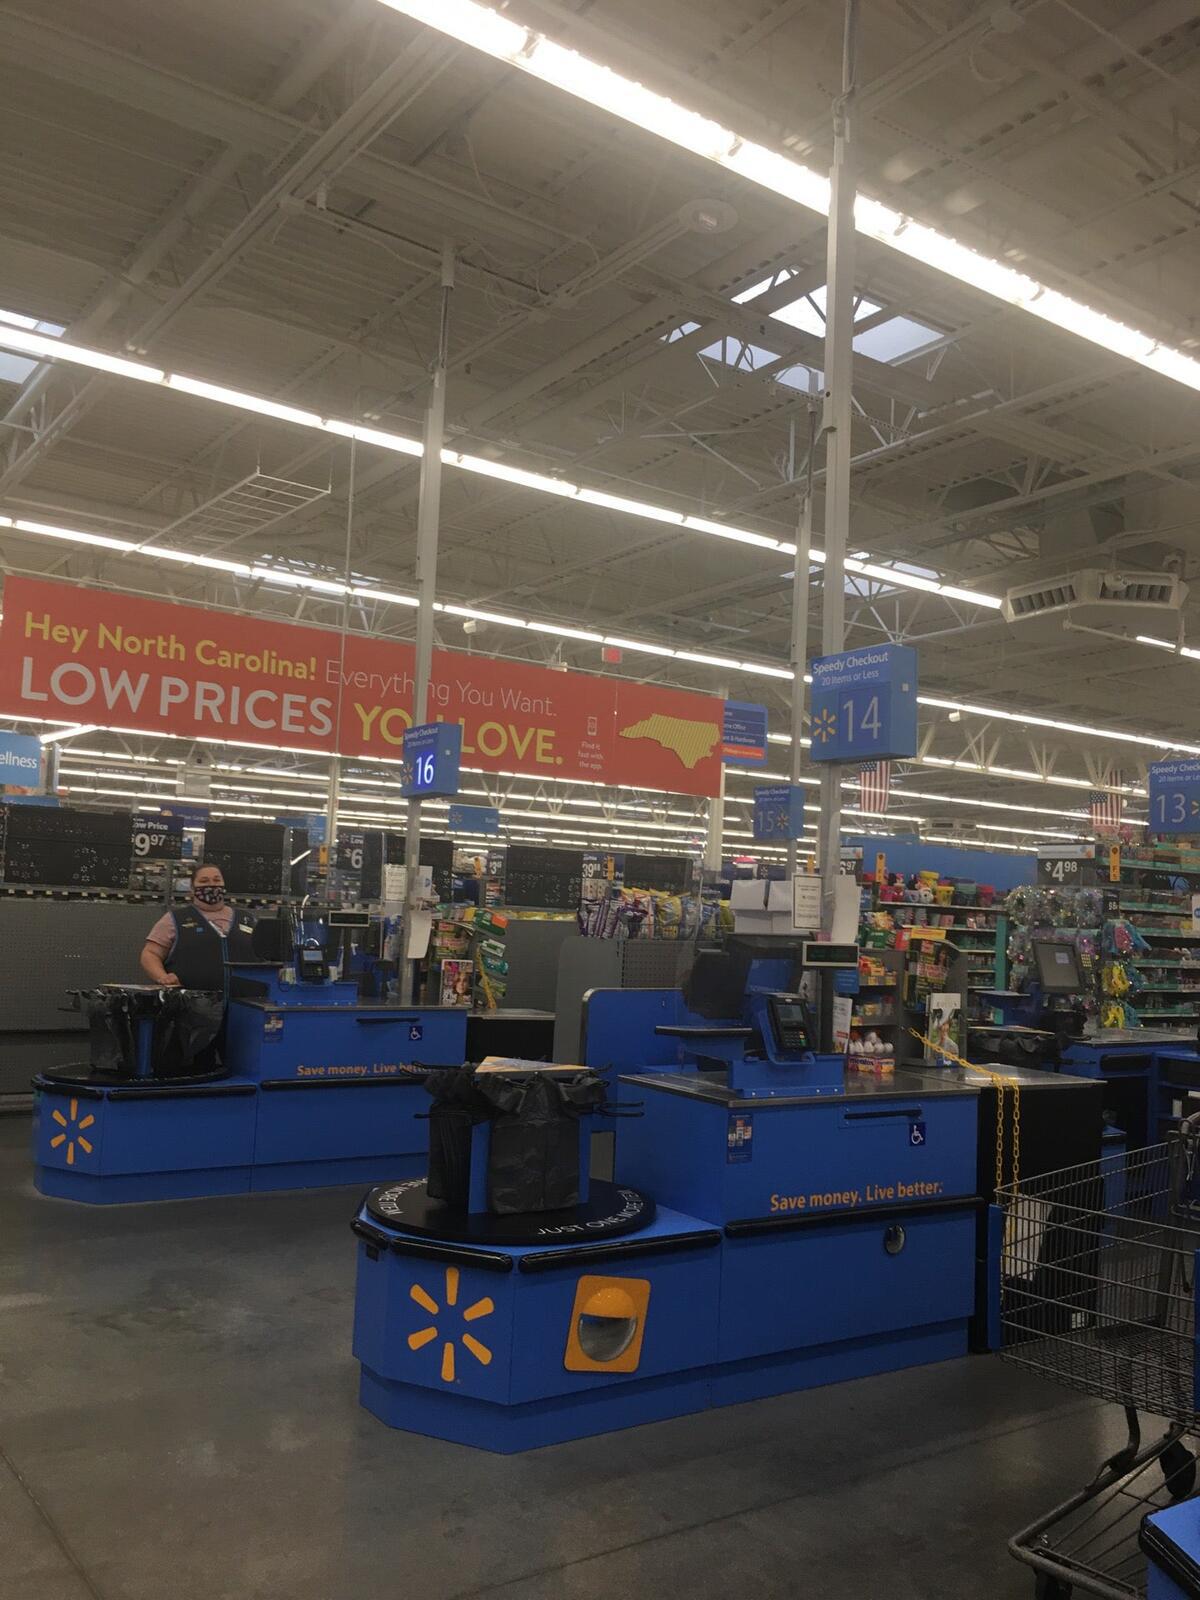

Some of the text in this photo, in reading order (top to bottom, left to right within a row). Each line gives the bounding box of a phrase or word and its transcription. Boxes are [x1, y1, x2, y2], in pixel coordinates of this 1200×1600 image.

[24, 611, 556, 717] Hey North Carolina! Everythng You Want.
[813, 652, 889, 676] Speedy Checkout
[822, 670, 879, 686] 20 Items or Less
[20, 656, 150, 713] LOW
[159, 677, 333, 737] PRICES
[354, 702, 443, 746] YO
[843, 696, 882, 743] 14
[416, 754, 434, 785] 16
[1152, 764, 1178, 775] Speedy
[1156, 793, 1186, 824] 13
[147, 821, 169, 831] Price
[758, 811, 775, 832] 15
[297, 1065, 325, 1076] Save
[328, 1065, 370, 1077] money.
[373, 1063, 398, 1073] Live
[770, 1181, 943, 1212] Save money. Live better.
[538, 1224, 585, 1235] JUST
[586, 1215, 626, 1228] ONE
